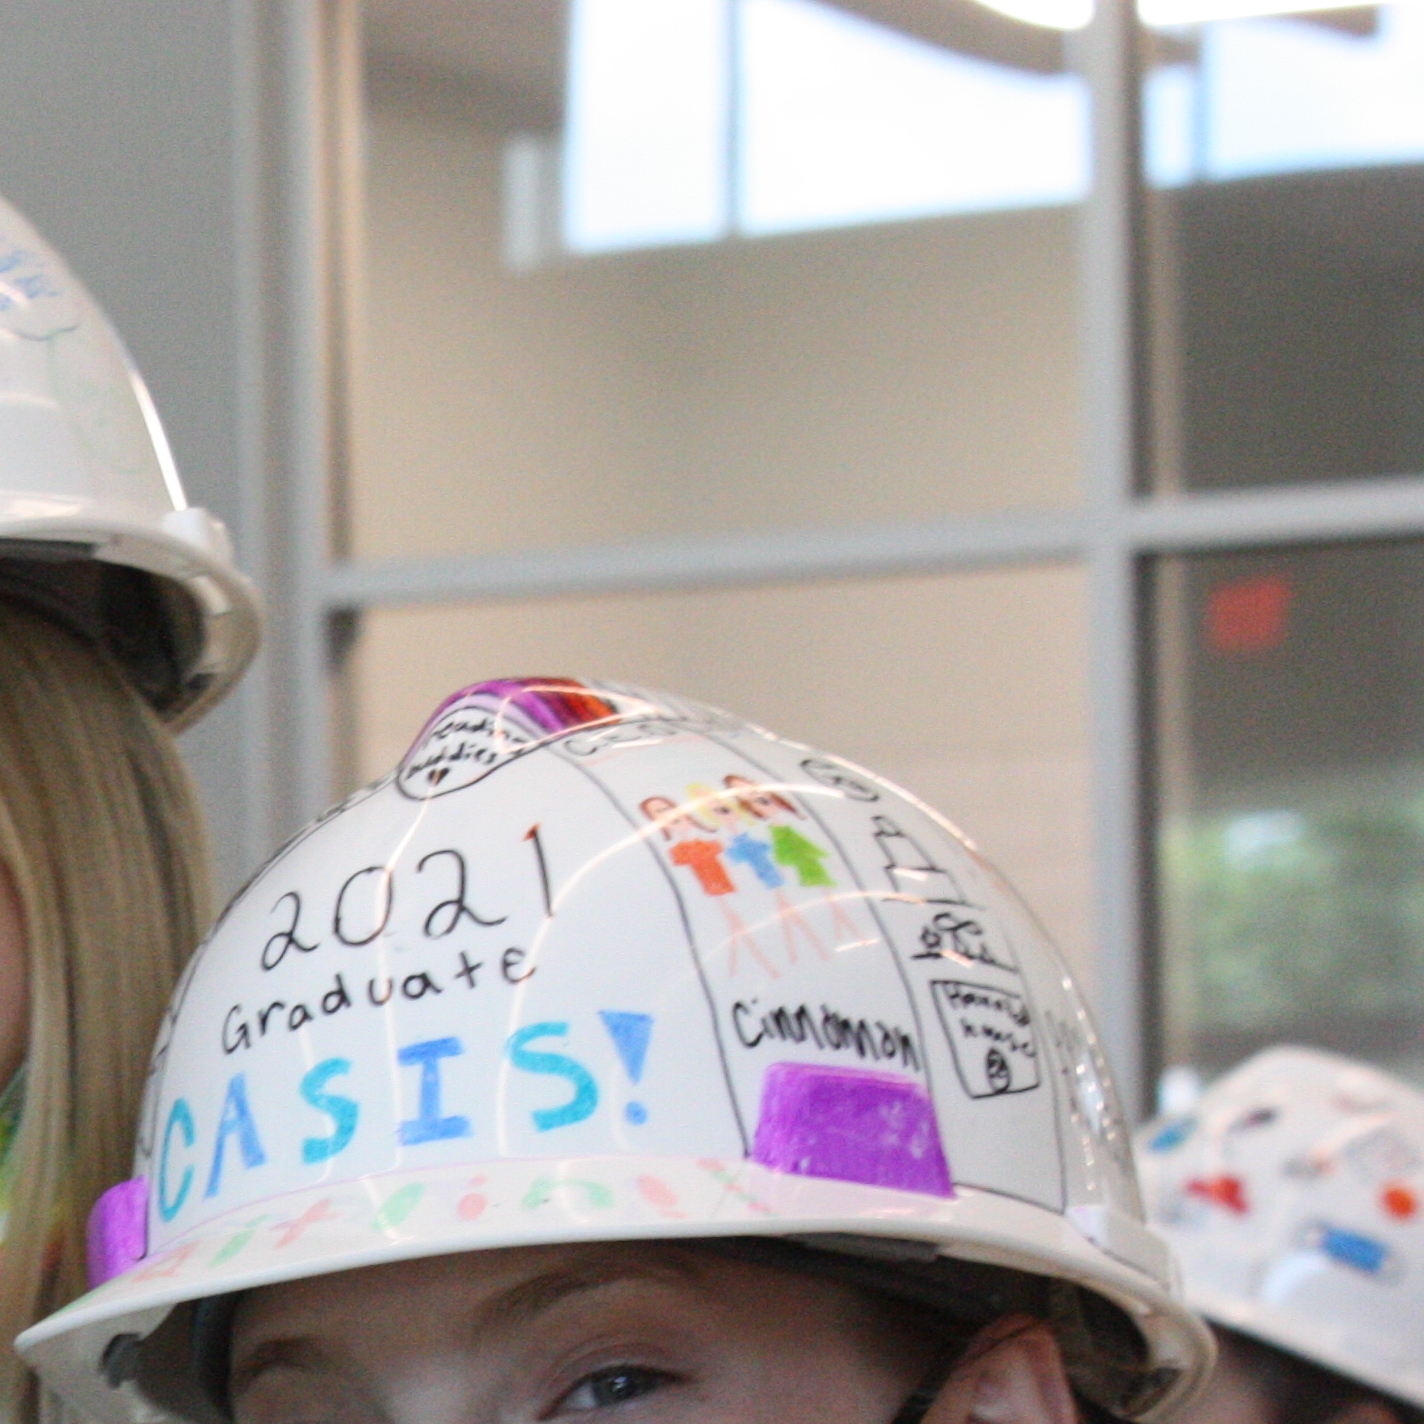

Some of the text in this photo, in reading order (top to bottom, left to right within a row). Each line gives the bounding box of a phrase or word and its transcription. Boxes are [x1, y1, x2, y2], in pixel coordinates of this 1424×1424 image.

[259, 823, 559, 971] 2021
[221, 946, 537, 1055] Graduate
[158, 1010, 653, 1224] CASIS!
